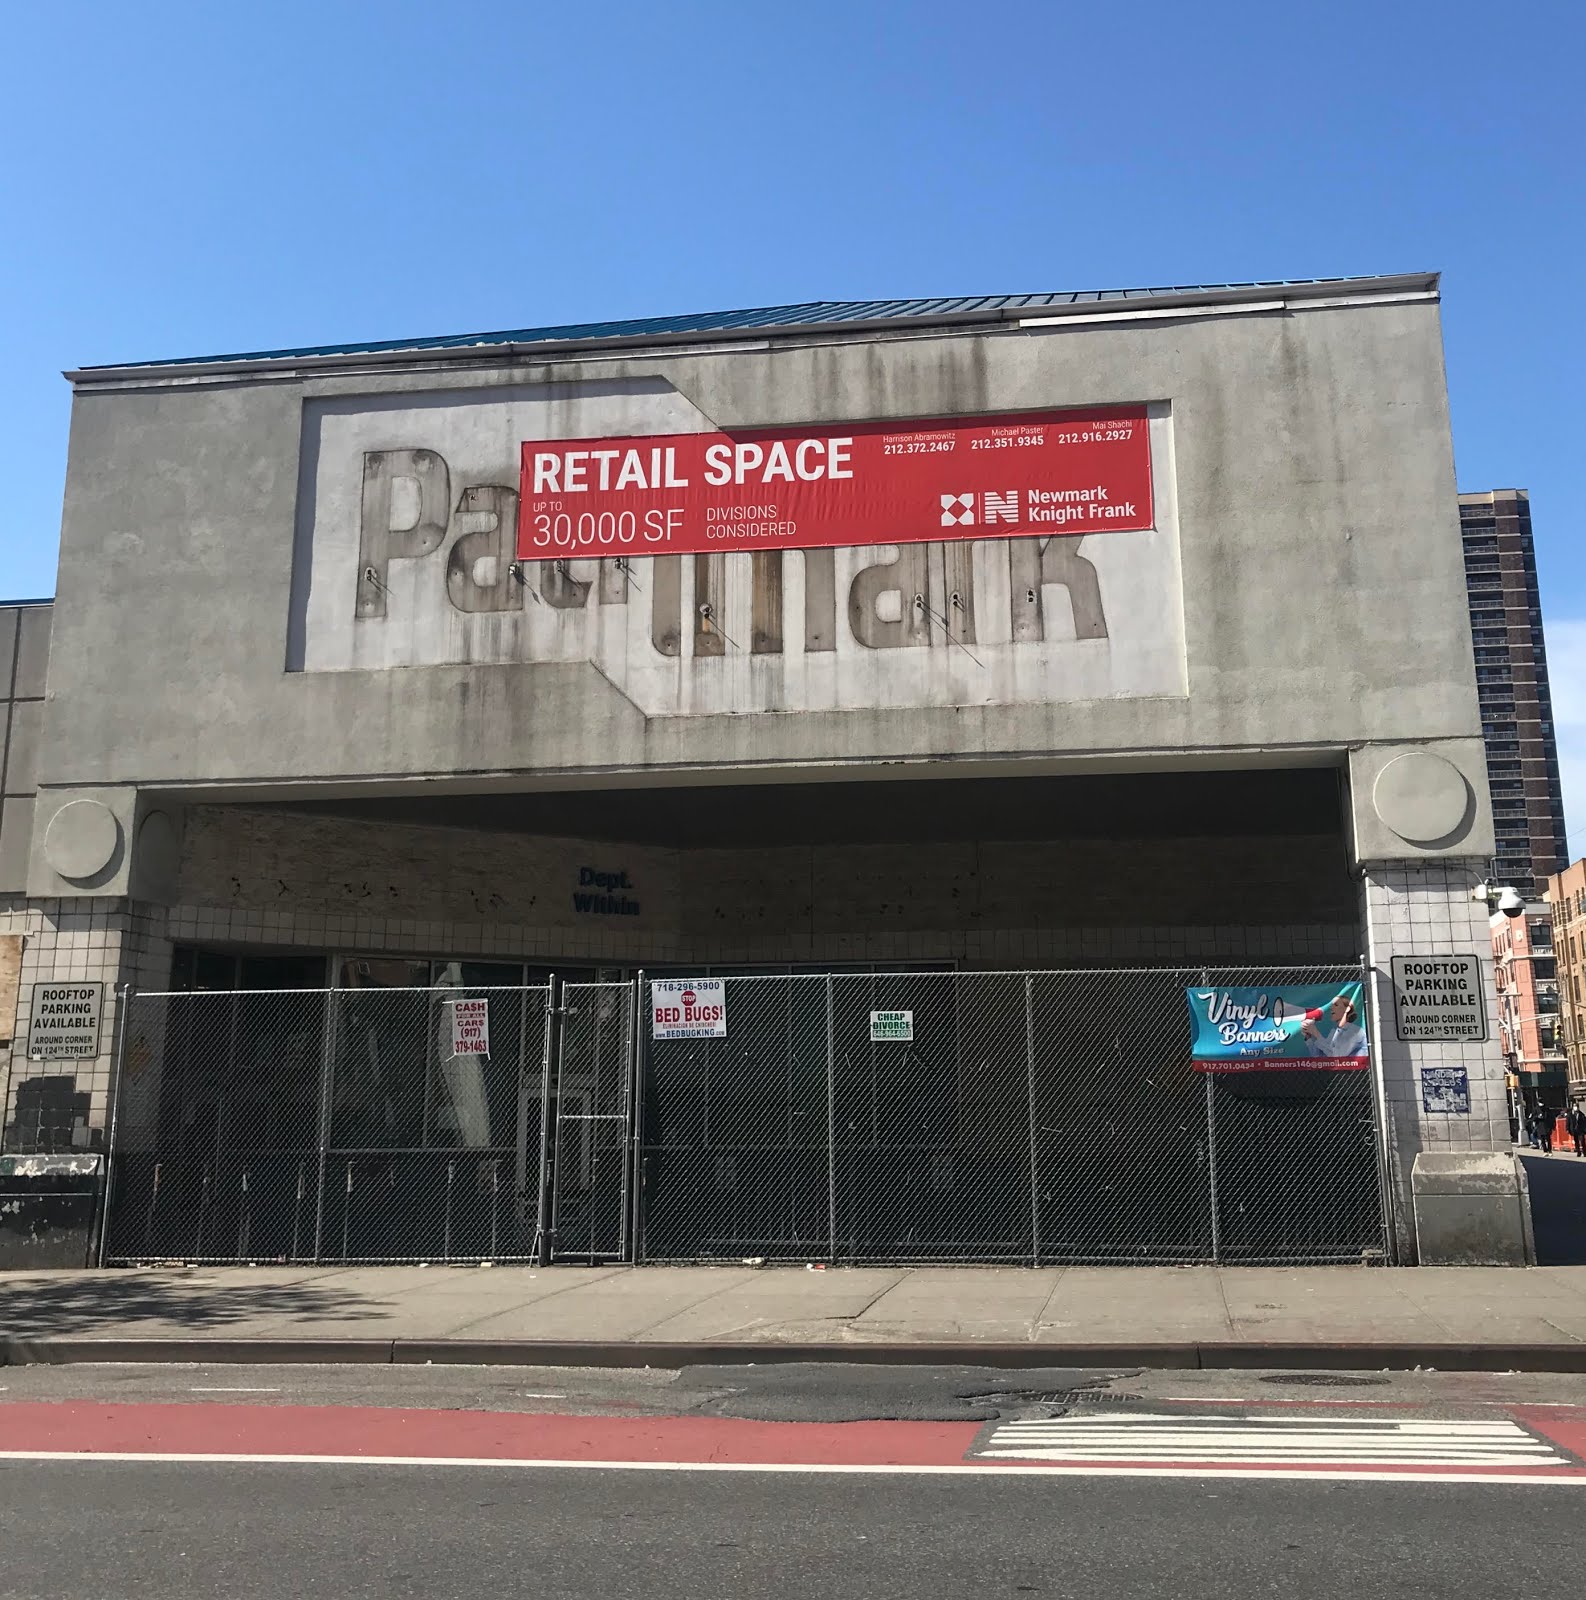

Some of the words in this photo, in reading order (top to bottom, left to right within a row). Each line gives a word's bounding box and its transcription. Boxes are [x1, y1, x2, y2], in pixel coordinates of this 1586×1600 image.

[1092, 421, 1105, 430] Mai
[1107, 419, 1132, 429] Shachi
[991, 427, 1019, 436] Michael
[1020, 426, 1044, 435] Paster
[1058, 429, 1132, 444] 212.916.2927
[883, 434, 912, 443] Harrison
[914, 432, 956, 442] Abramowitz
[971, 435, 1044, 450] 212.351.9345
[884, 441, 956, 455] 212.372.2467
[533, 447, 689, 494] RETAIL
[703, 437, 854, 486] SPACE
[1028, 485, 1108, 504] Newmark
[533, 502, 547, 512] UP
[549, 501, 562, 512] TO
[706, 504, 777, 521] DIVISIONS
[1028, 504, 1087, 525] Knight
[1089, 501, 1136, 519] Frank
[533, 511, 636, 550] 30,000
[643, 508, 685, 542] SF
[706, 521, 797, 539] CONSIDERED
[580, 867, 632, 892] Dept.
[573, 893, 640, 915] Within
[1404, 963, 1469, 975] ROOFTOP
[657, 981, 720, 991] 718-296-5900
[1406, 979, 1467, 990] PARKING
[42, 989, 95, 1000] ROOFTOP
[1400, 994, 1476, 1006] AVAILABLE
[41, 1003, 91, 1014] PARKING
[655, 1007, 680, 1023] BED
[684, 1005, 723, 1022] BUGS!
[1198, 991, 1269, 1029] Vinyl
[34, 1017, 96, 1028] AVAILABLE
[877, 1013, 905, 1021] CHEAP
[1405, 1015, 1439, 1023] AROUND
[1441, 1014, 1476, 1023] CORNER
[873, 1021, 911, 1030] DIVORCE
[1403, 1027, 1416, 1035] ON
[1444, 1025, 1479, 1034] STREET
[461, 1027, 481, 1039] (917)
[1218, 1022, 1291, 1046] Banners
[35, 1036, 63, 1044] AROUND
[65, 1046, 94, 1054] STREET
[455, 1040, 487, 1053] 379-1463
[1240, 1048, 1260, 1057] Any
[1263, 1047, 1284, 1055] Size
[1264, 1060, 1359, 1069] Banners146@gmail.com
